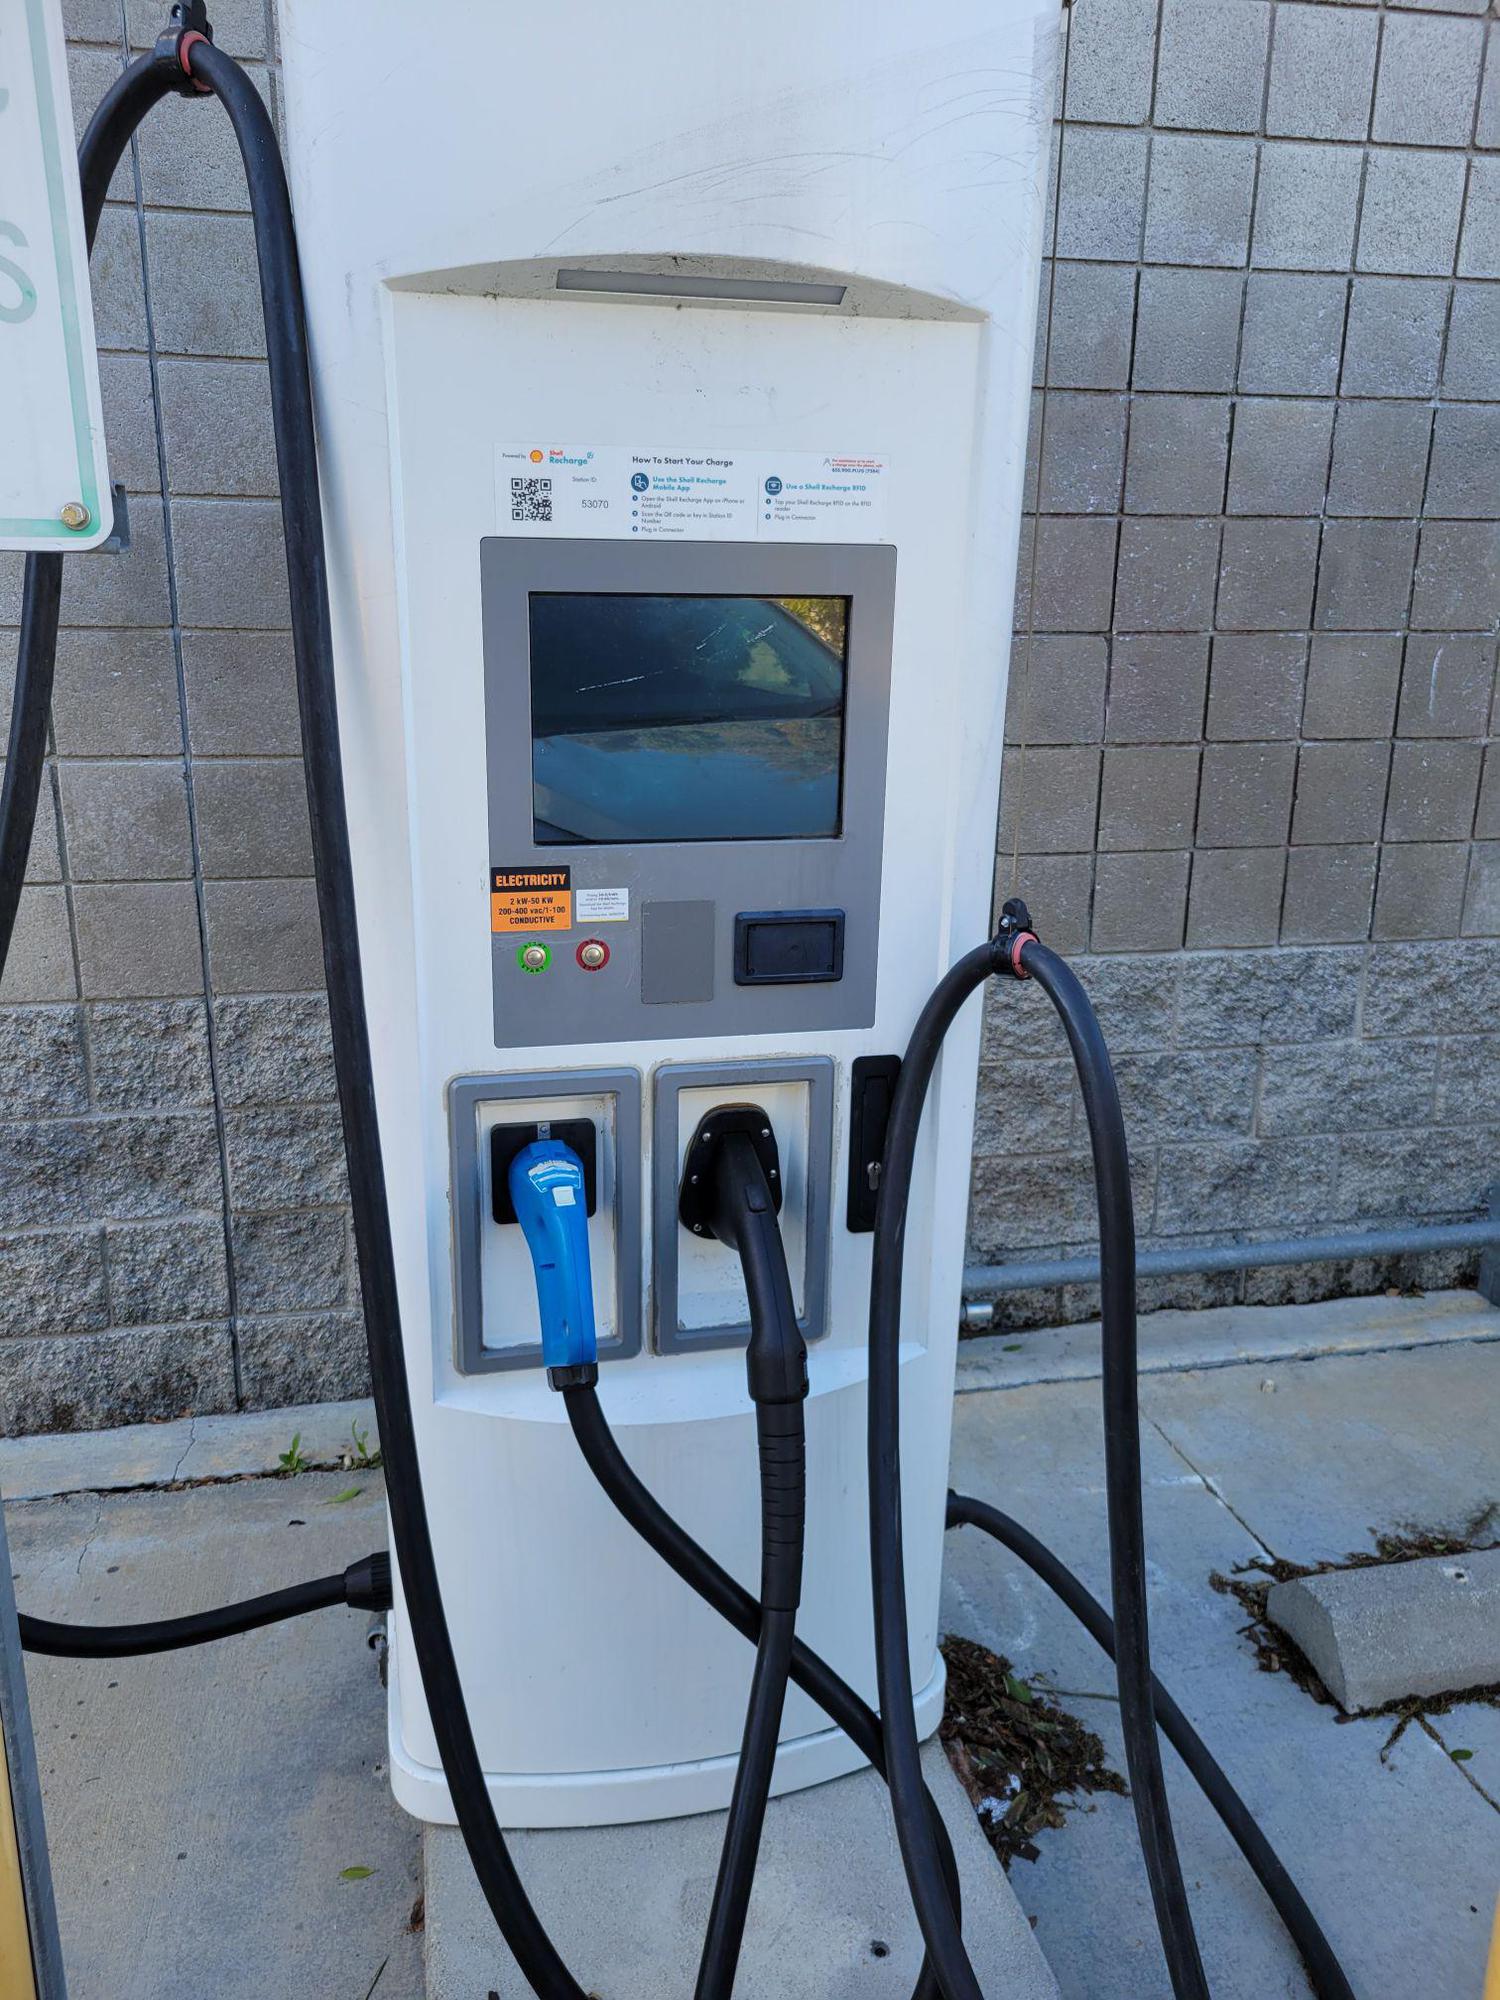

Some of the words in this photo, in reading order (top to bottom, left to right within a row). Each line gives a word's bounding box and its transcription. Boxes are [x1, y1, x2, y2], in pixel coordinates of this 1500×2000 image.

[549, 456, 588, 466] Recharge
[632, 456, 650, 464] How
[652, 456, 662, 464] To
[664, 457, 684, 465] Start
[685, 458, 704, 466] Your
[706, 458, 734, 468] Charge
[696, 477, 726, 486] Recharge
[582, 500, 609, 508] 53070
[496, 874, 566, 887] ELECTRICITY
[510, 916, 555, 924] CONDUCTIVE
